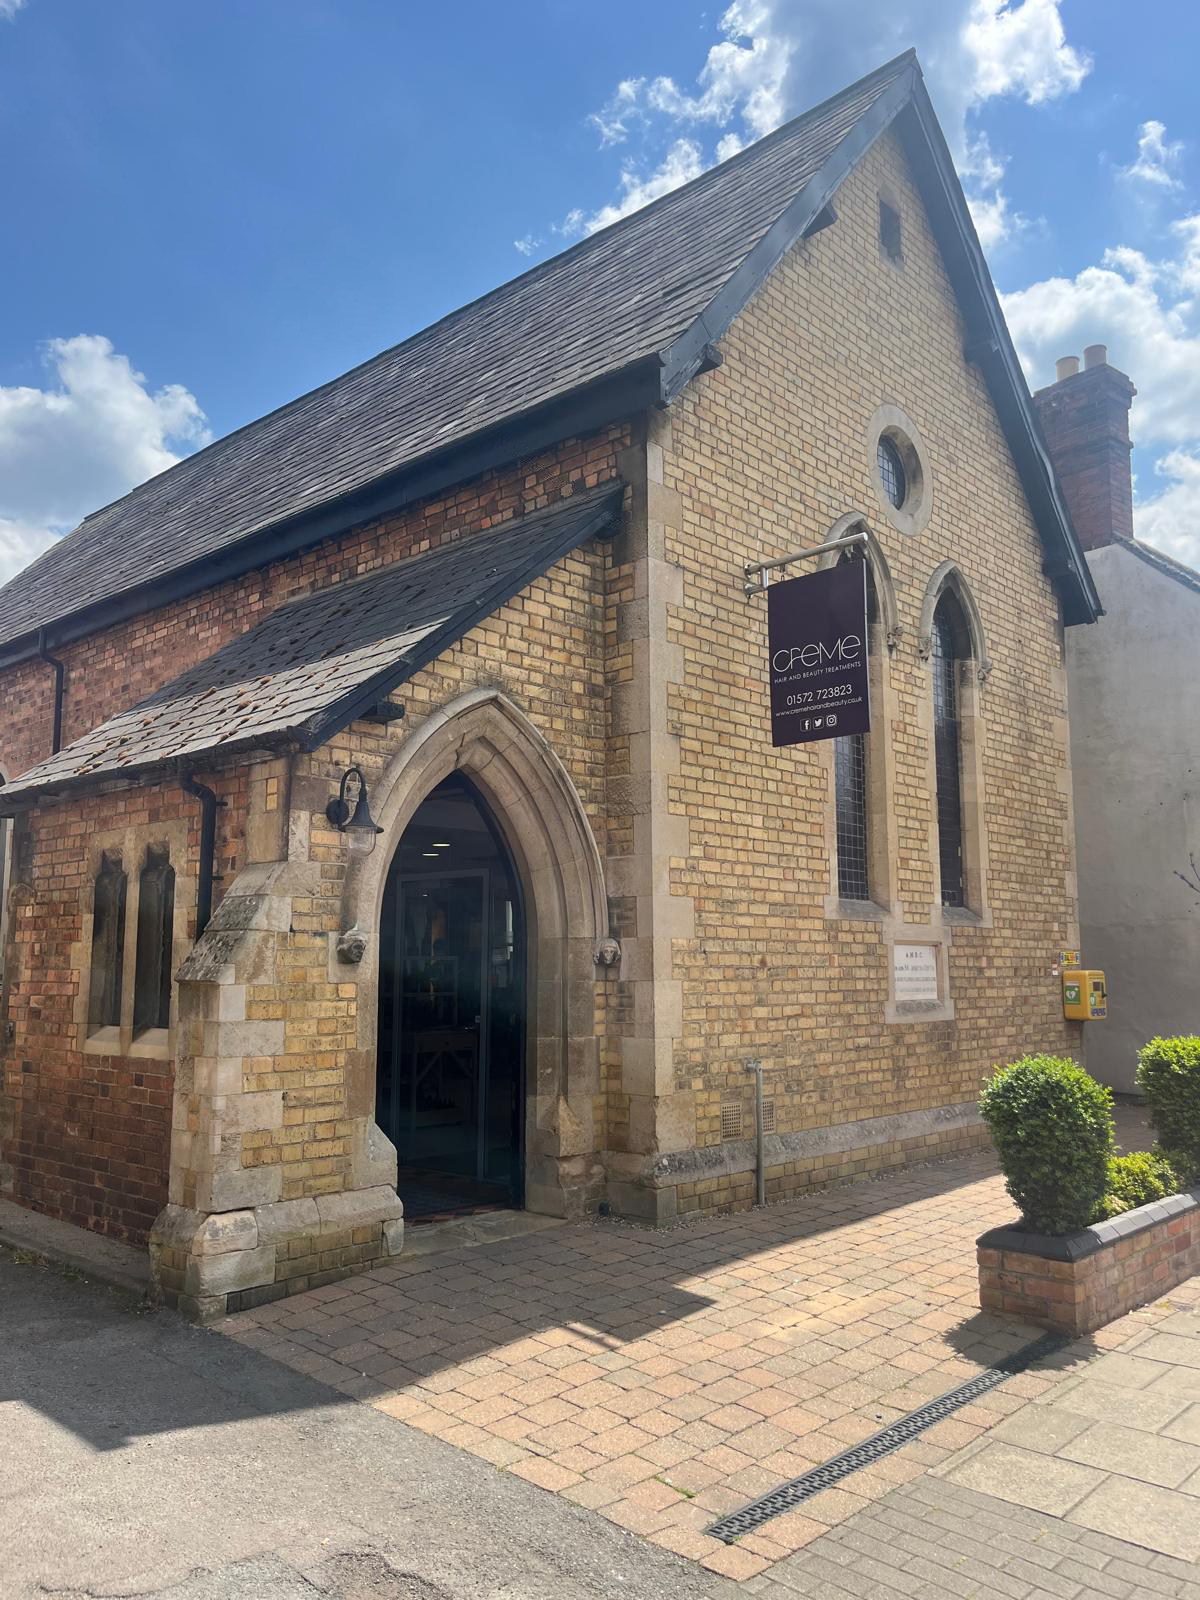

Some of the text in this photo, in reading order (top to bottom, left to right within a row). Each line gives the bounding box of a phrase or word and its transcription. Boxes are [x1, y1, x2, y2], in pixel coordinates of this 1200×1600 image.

[788, 673, 801, 681] AND
[802, 669, 824, 678] BEAUTY
[825, 661, 861, 673] TREATMENTS
[786, 684, 853, 706] 01572 723823
[775, 697, 863, 717] www.cremehairandbeauty.co.uk
